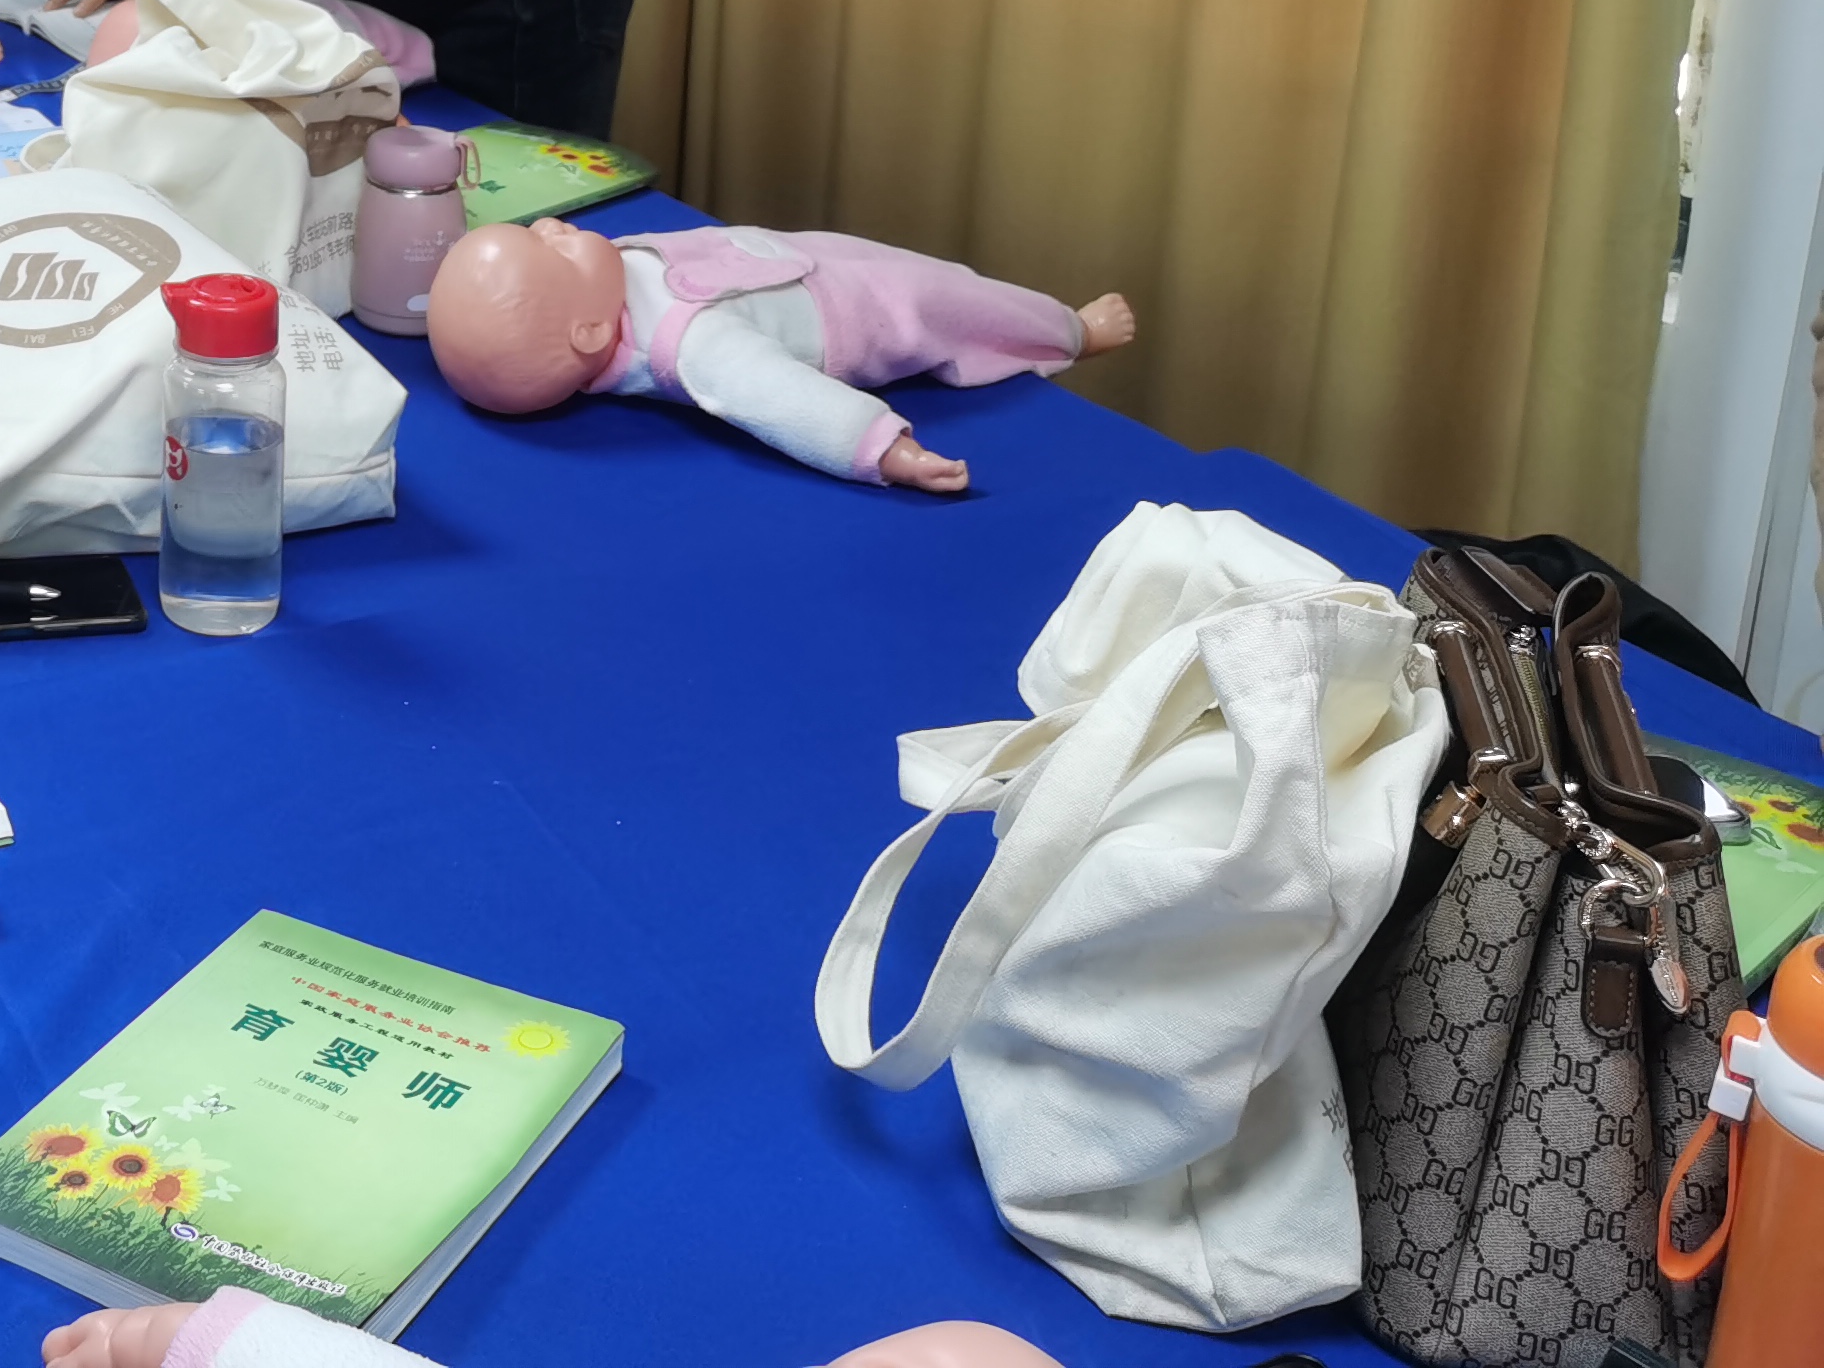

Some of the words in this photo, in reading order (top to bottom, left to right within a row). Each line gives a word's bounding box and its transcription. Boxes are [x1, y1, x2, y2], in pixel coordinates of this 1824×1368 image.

[23, 333, 47, 345] BAI
[230, 1002, 473, 1111] 育婴师
